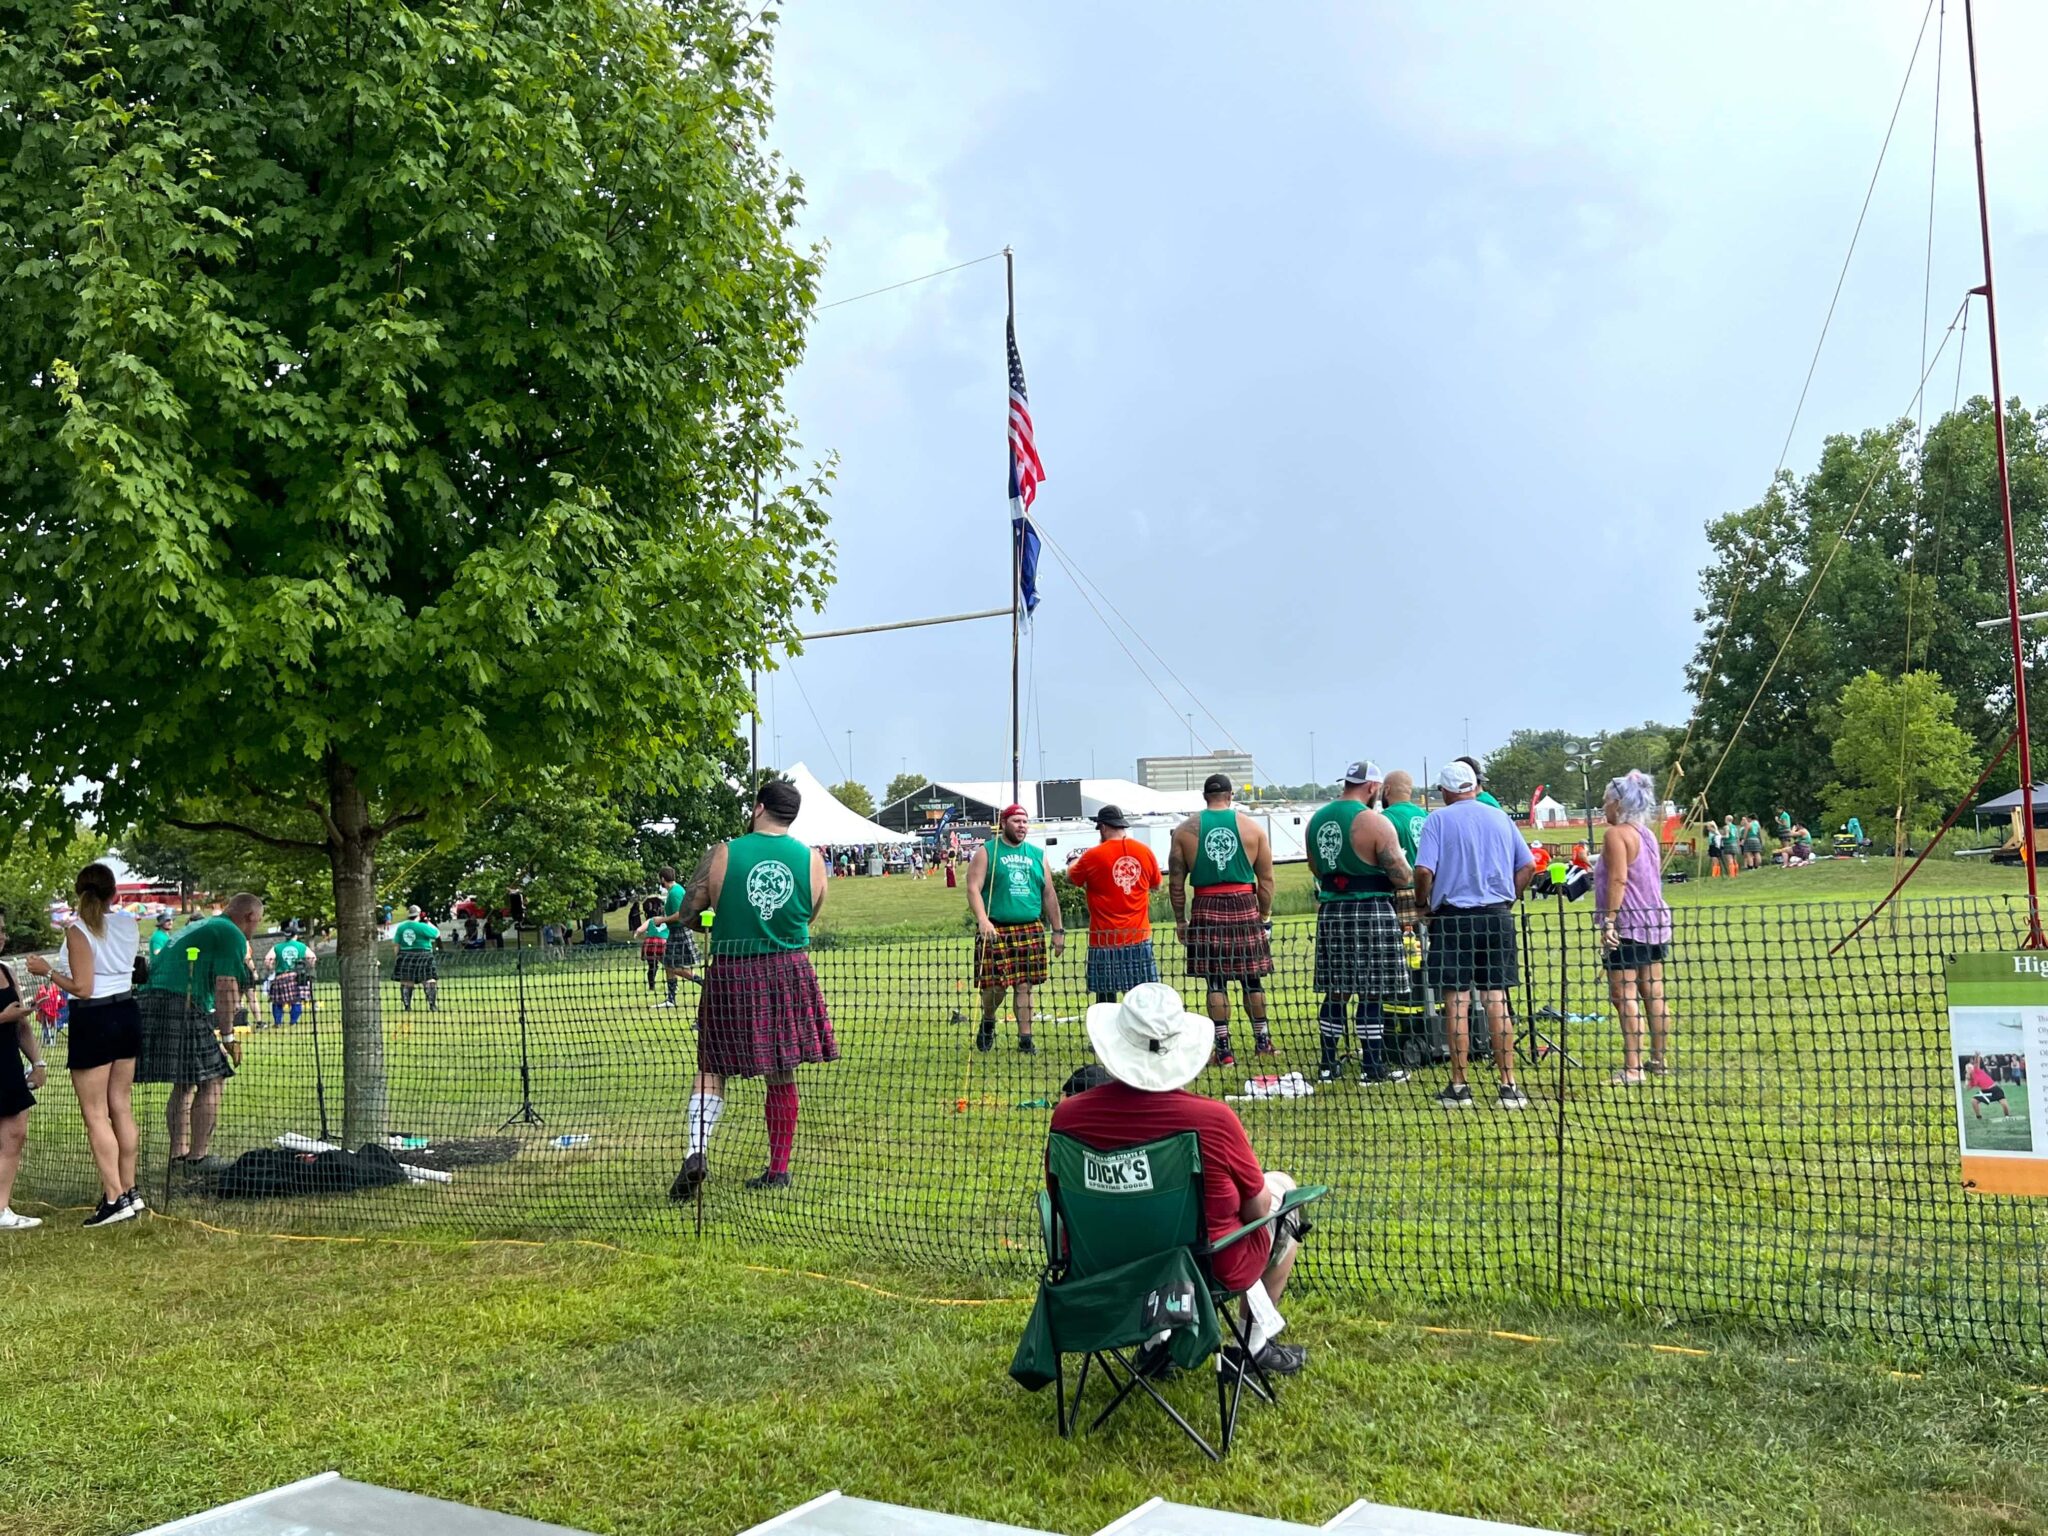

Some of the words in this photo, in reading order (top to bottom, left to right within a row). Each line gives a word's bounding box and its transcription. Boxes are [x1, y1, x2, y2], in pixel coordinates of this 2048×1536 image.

[1000, 854, 1033, 866] DUBLIN
[2013, 956, 2048, 978] Hig
[1117, 1152, 1138, 1160] STARTS
[1087, 1159, 1147, 1184] DICK'S
[1123, 1182, 1149, 1190] GOODS
